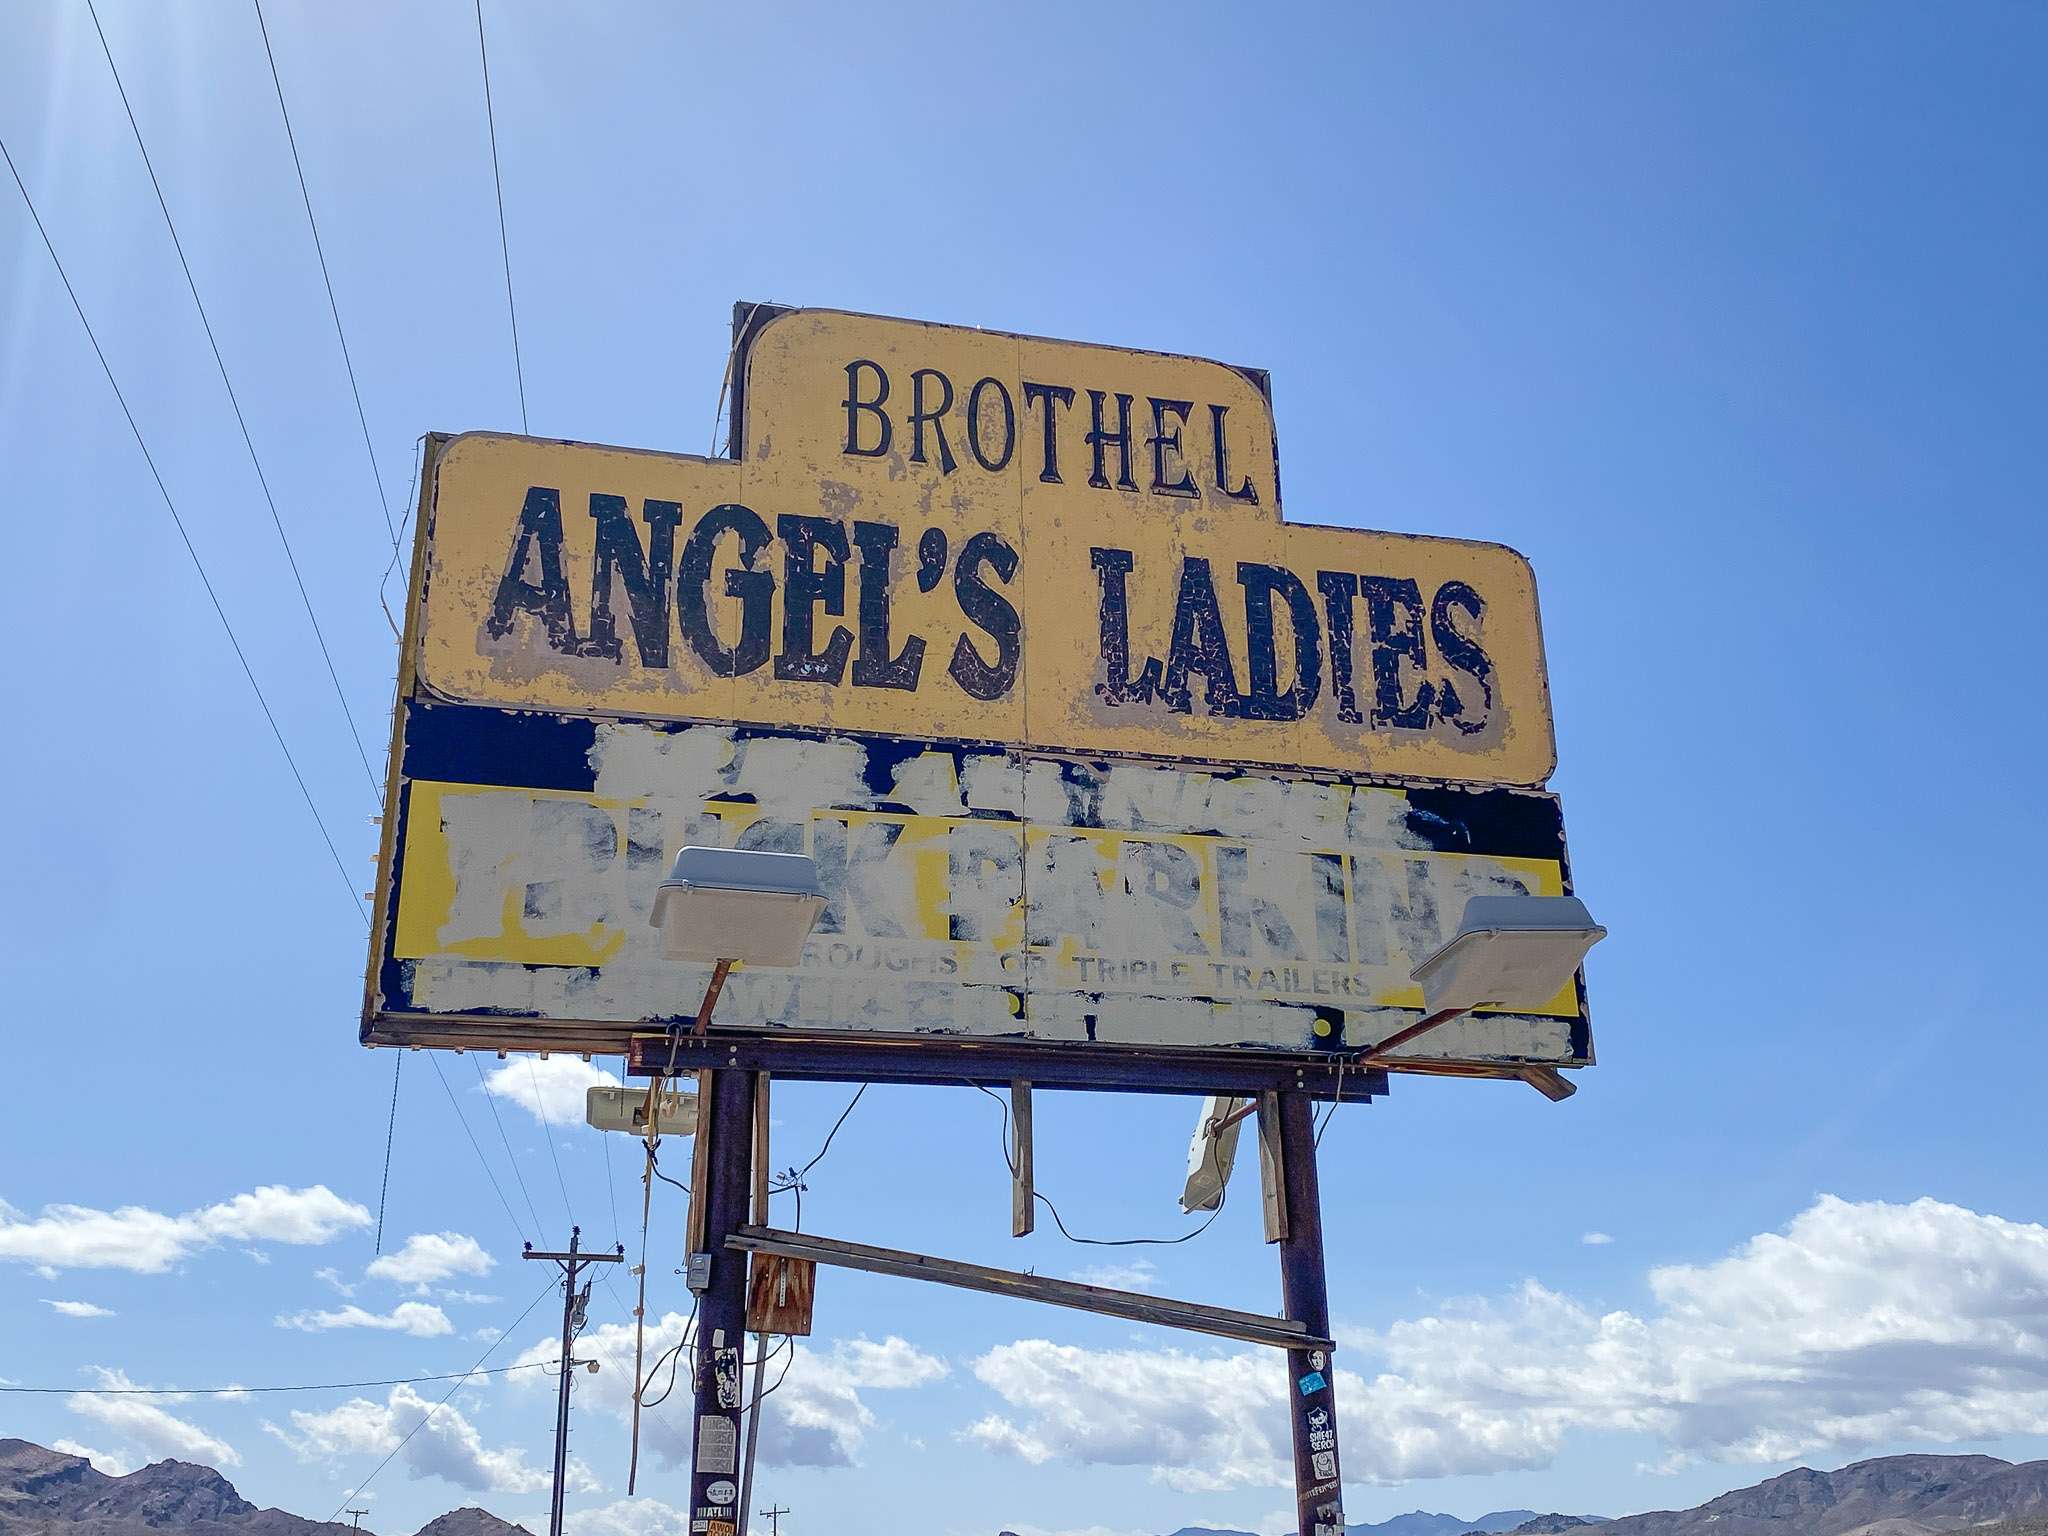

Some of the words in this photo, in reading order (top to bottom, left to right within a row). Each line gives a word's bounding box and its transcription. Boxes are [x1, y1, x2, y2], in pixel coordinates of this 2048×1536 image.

[842, 359, 1259, 505] BROTHEL
[487, 487, 1020, 700] ANGEL'S
[1090, 547, 1493, 735] LADIES
[1072, 957, 1189, 985] TRIPLE
[1208, 963, 1371, 997] TRAILERS
